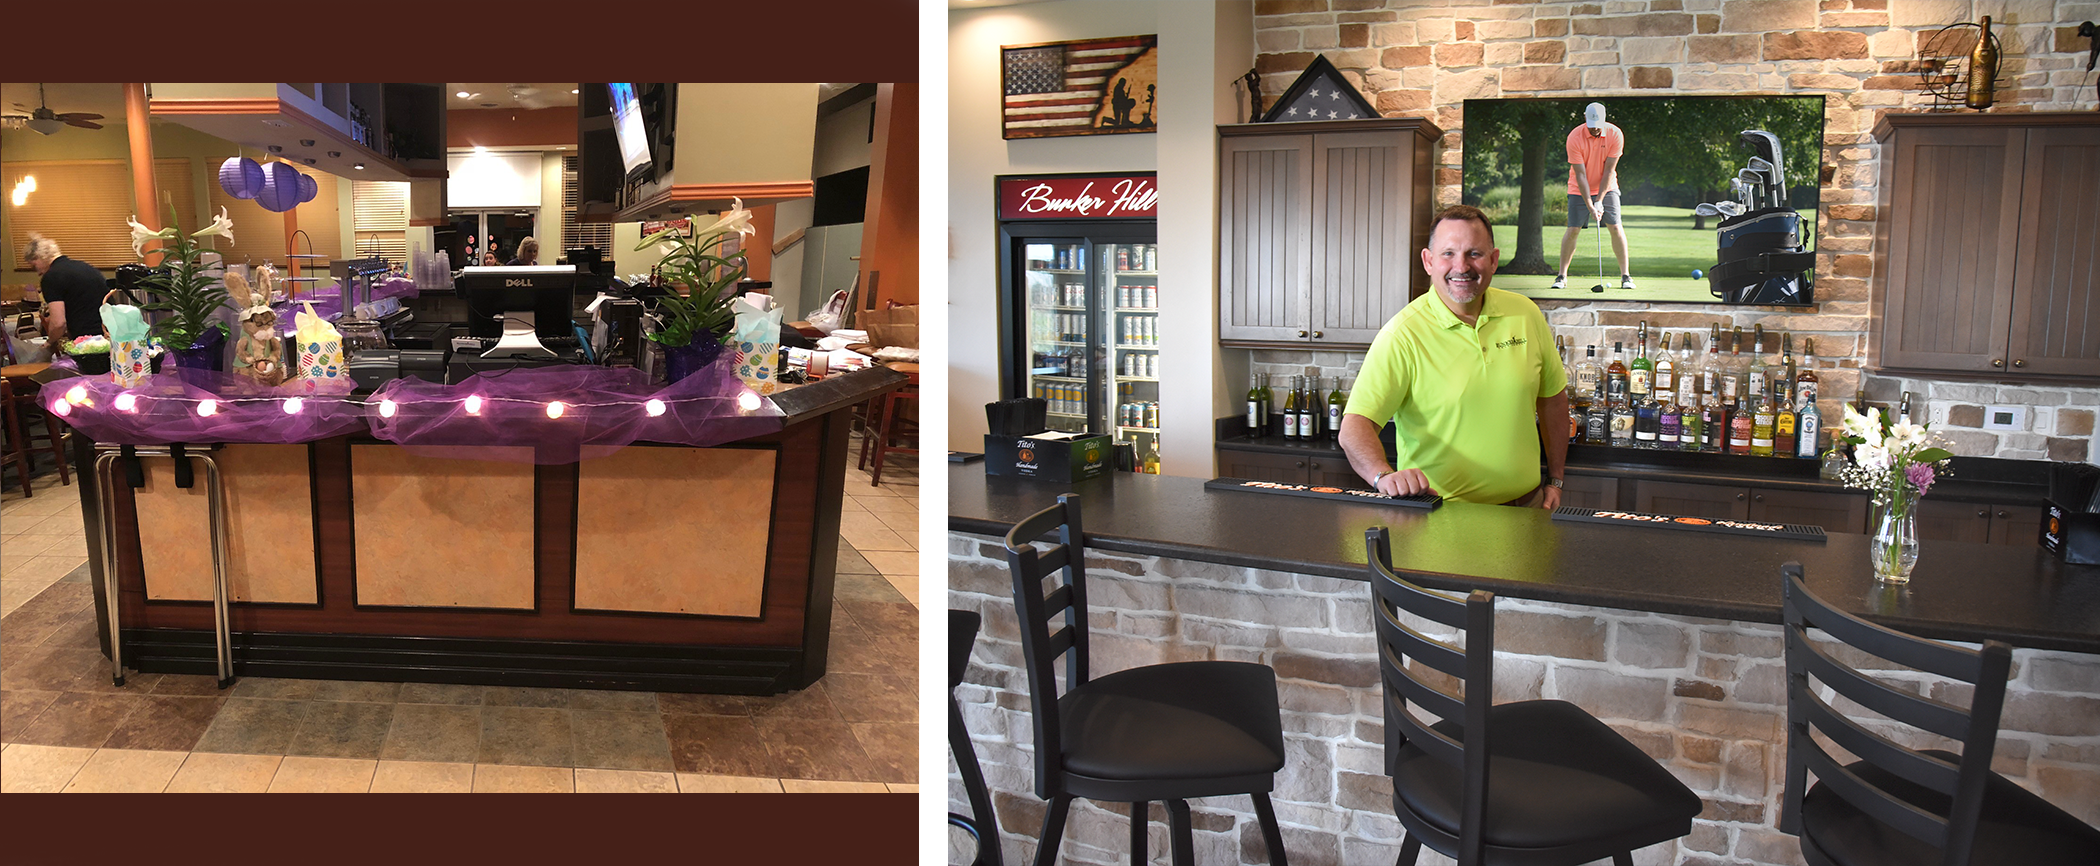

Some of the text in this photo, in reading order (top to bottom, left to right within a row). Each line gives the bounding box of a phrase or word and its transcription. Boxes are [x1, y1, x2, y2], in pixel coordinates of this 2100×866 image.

[1019, 179, 1158, 216] Bunker Hill
[505, 279, 533, 287] DELL
[1017, 440, 1036, 449] Tito's
[1085, 441, 1100, 451] Tito's
[1016, 461, 1038, 470] Handmade
